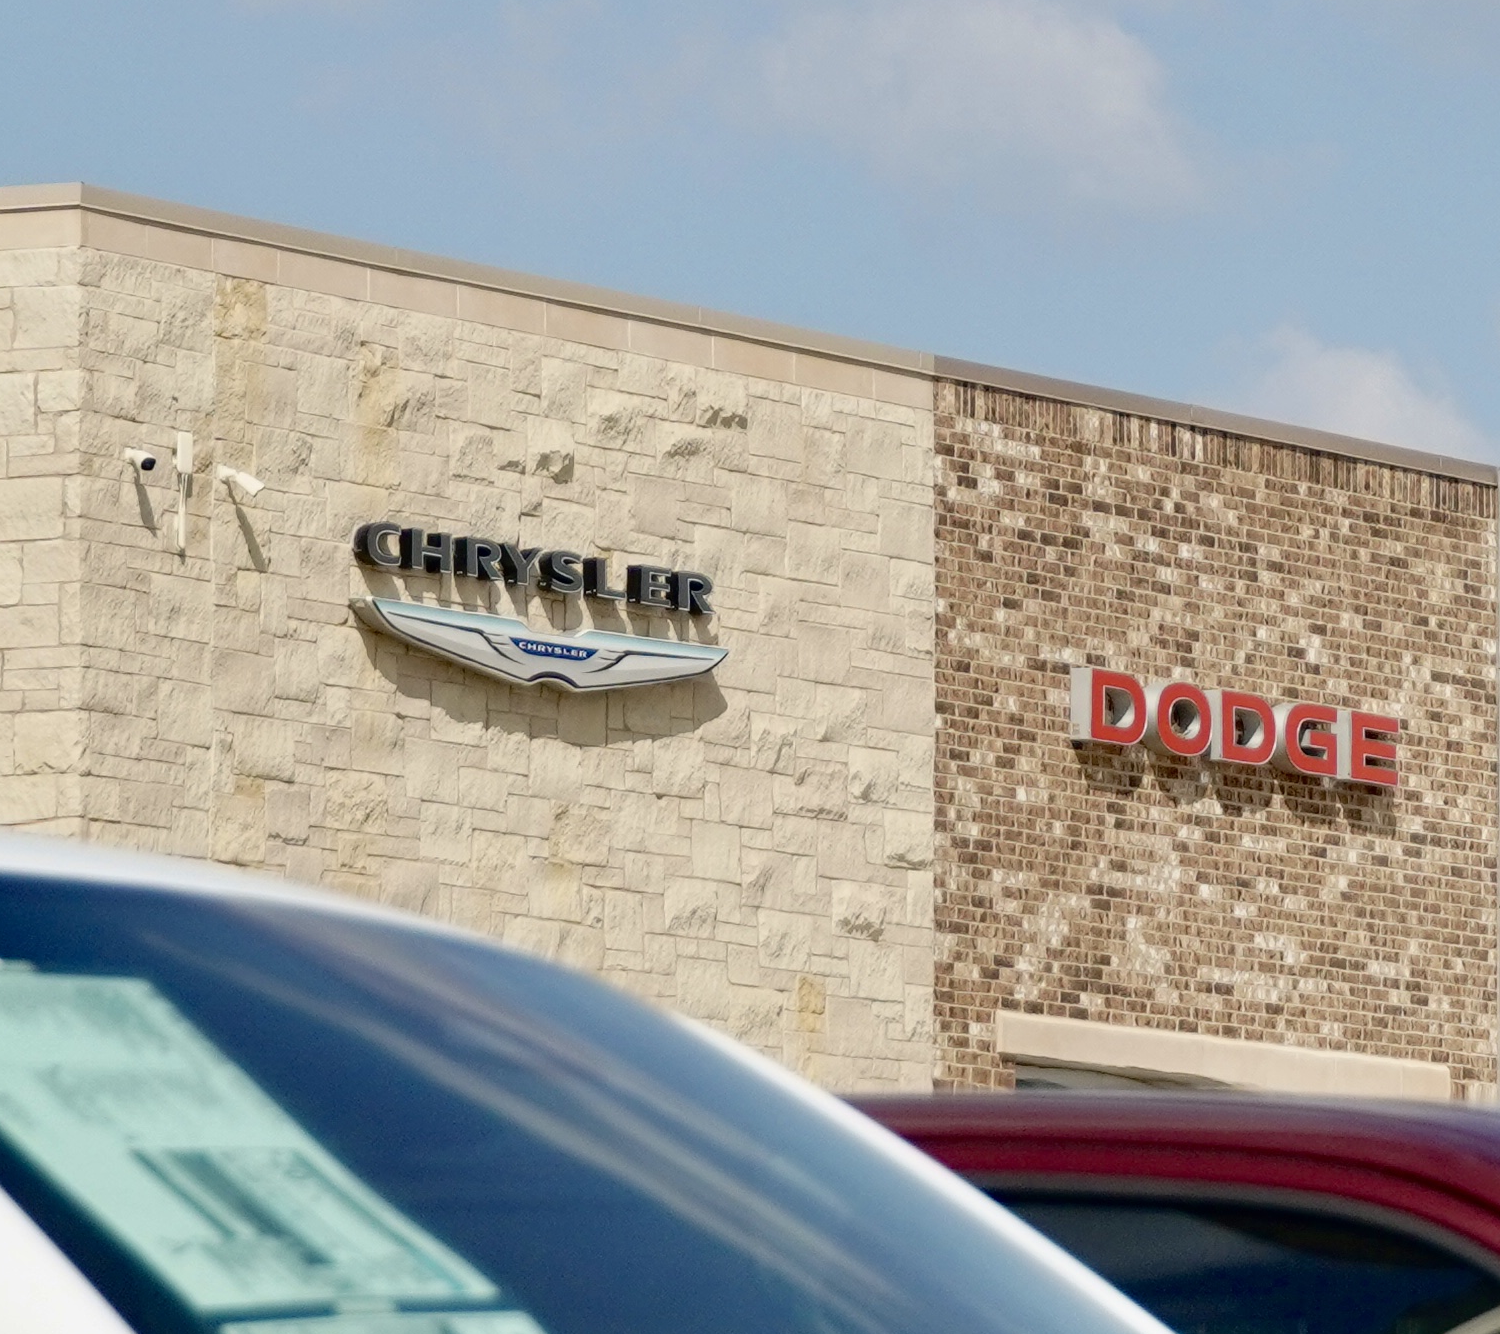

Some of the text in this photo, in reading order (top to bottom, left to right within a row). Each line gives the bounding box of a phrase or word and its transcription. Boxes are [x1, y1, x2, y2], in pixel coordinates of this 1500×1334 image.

[354, 521, 716, 615] CHRYSLER
[518, 641, 588, 659] CHRYSLER
[1071, 667, 1400, 786] DODGE
